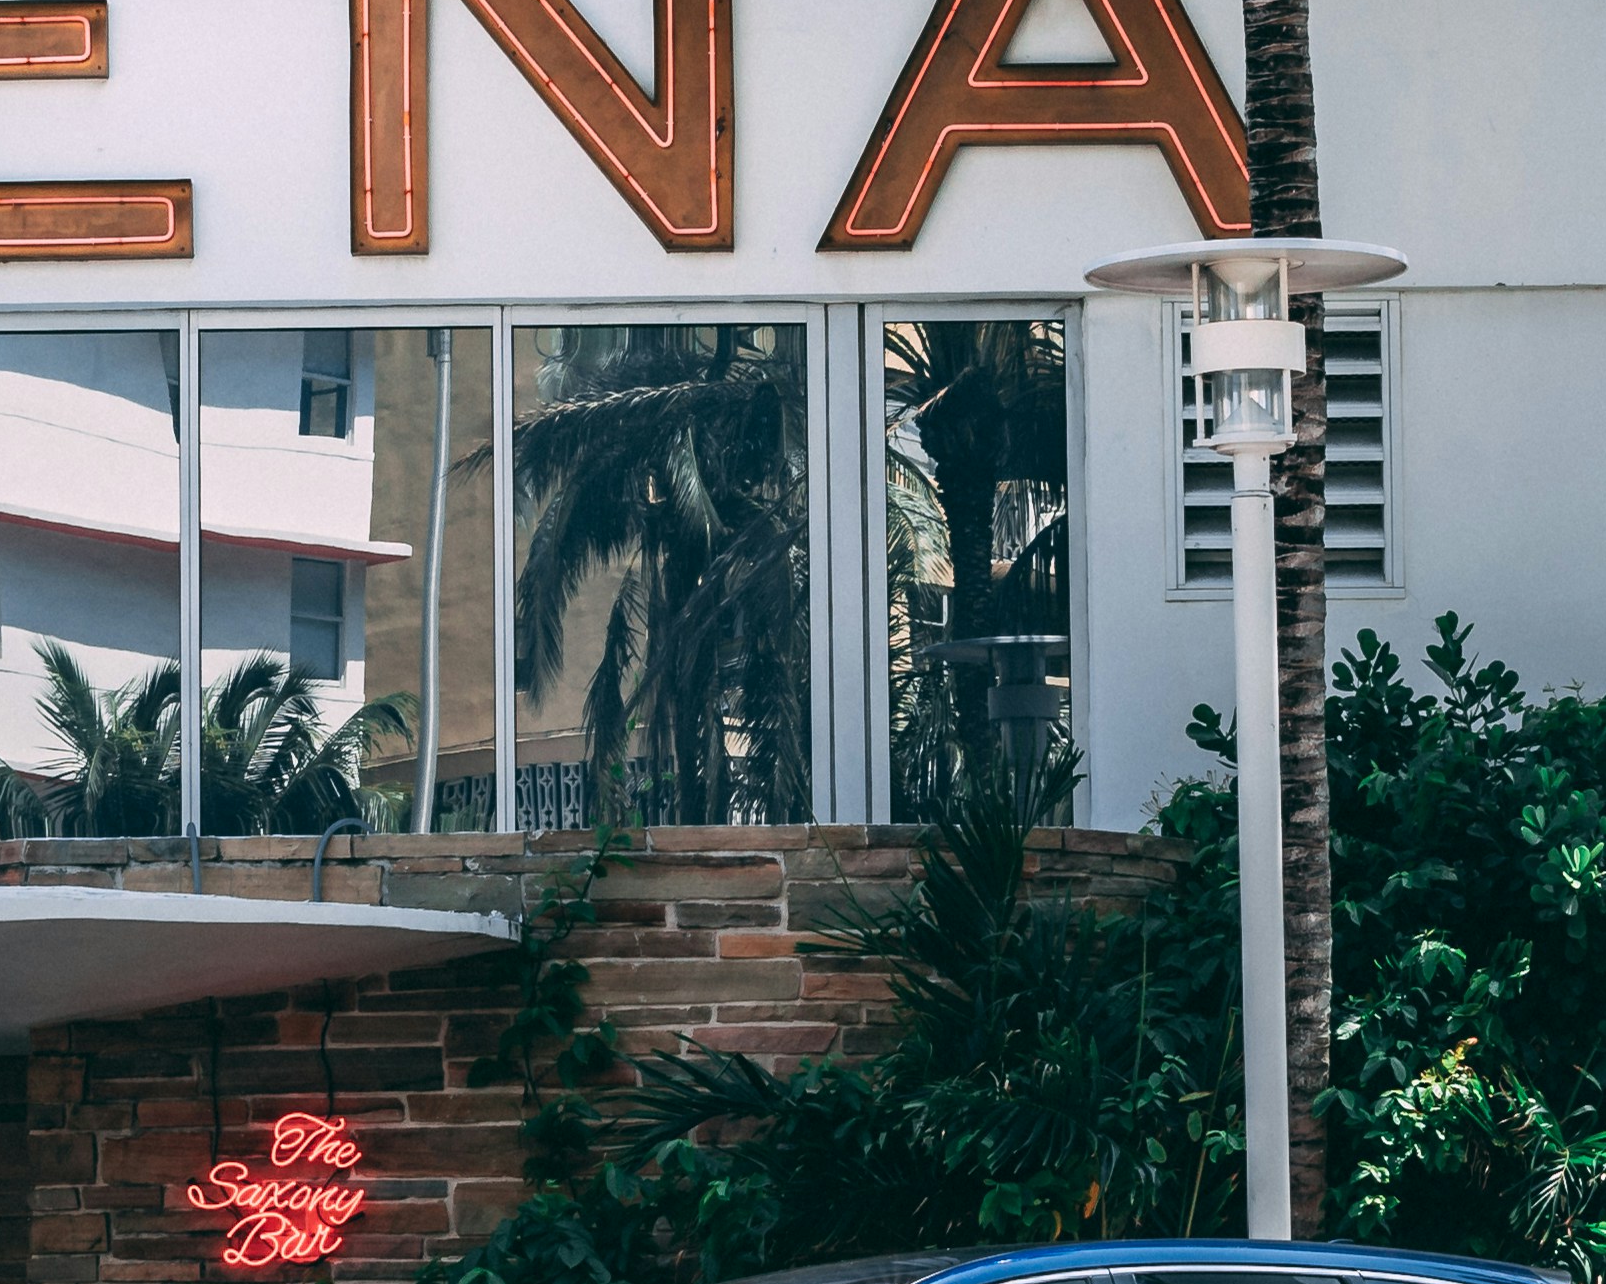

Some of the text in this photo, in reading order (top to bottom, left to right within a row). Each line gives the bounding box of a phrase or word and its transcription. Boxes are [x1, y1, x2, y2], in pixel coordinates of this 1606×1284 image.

[271, 1112, 362, 1168] The
[187, 1161, 364, 1225] Saxony
[223, 1211, 343, 1266] Bar
